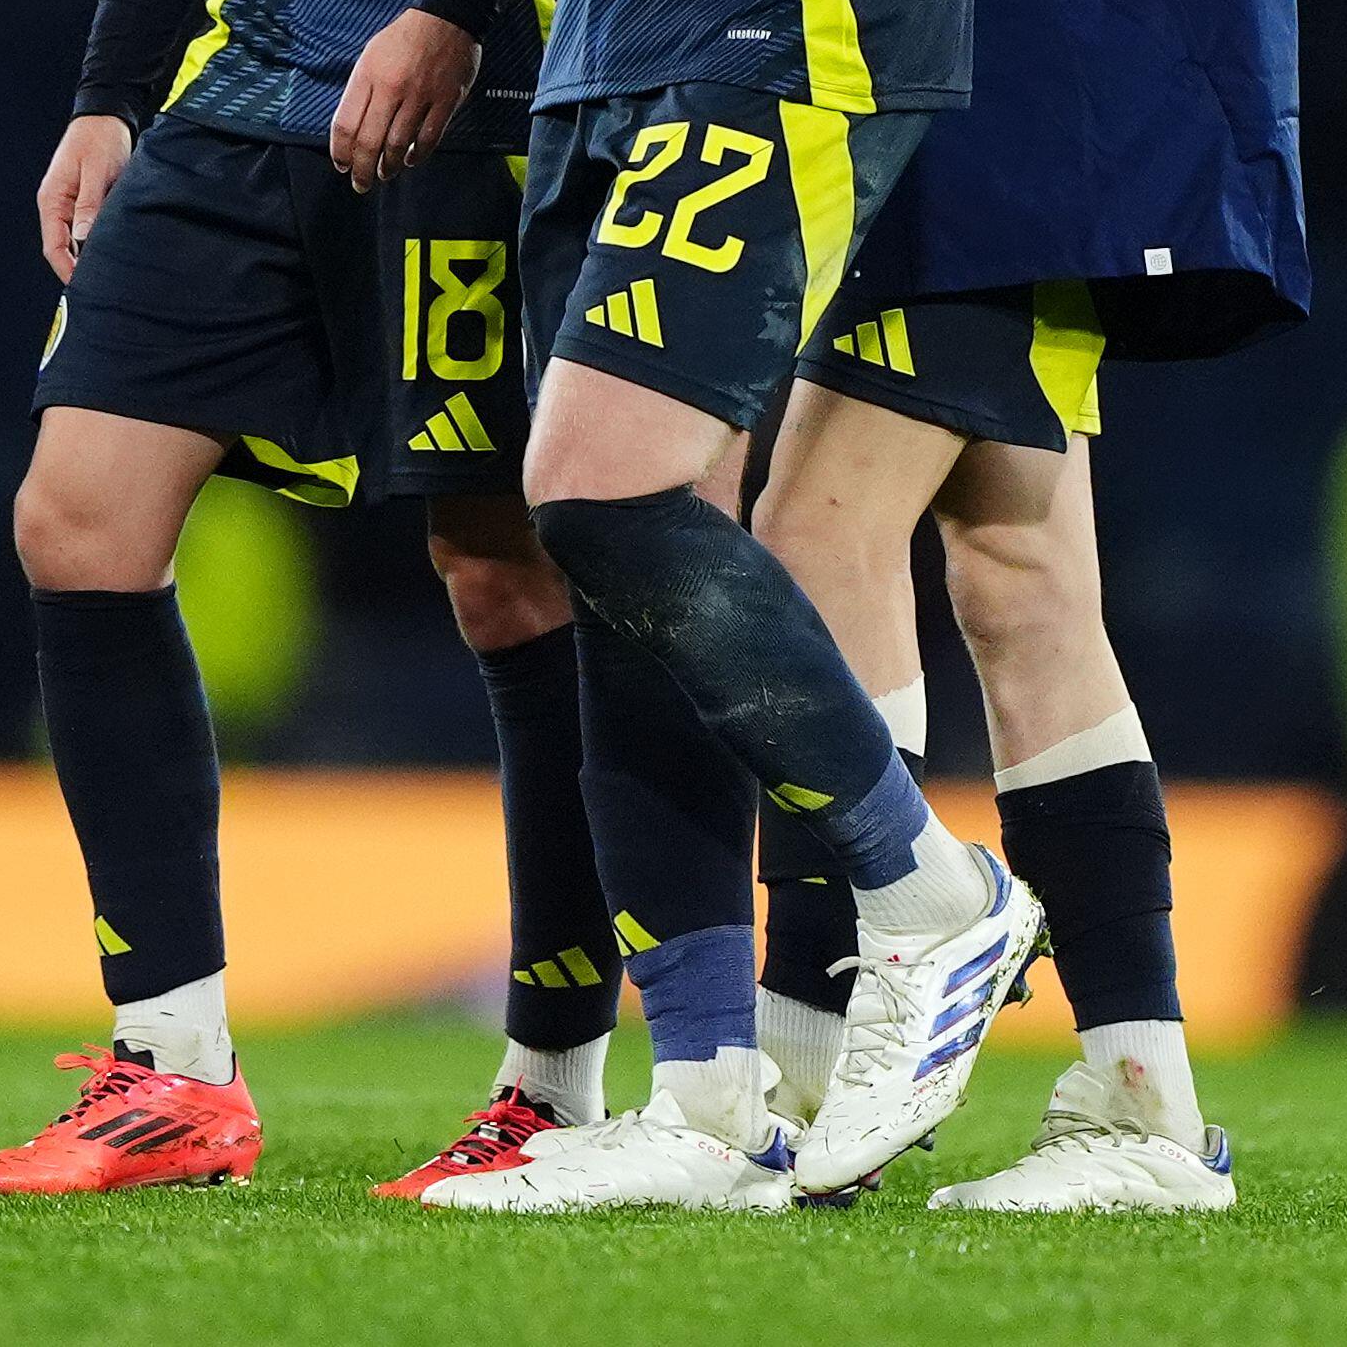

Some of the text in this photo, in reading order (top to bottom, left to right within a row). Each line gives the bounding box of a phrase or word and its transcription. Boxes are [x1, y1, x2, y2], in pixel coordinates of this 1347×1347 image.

[596, 120, 775, 273] 22
[403, 238, 507, 382] 18
[698, 1141, 730, 1162] COPA
